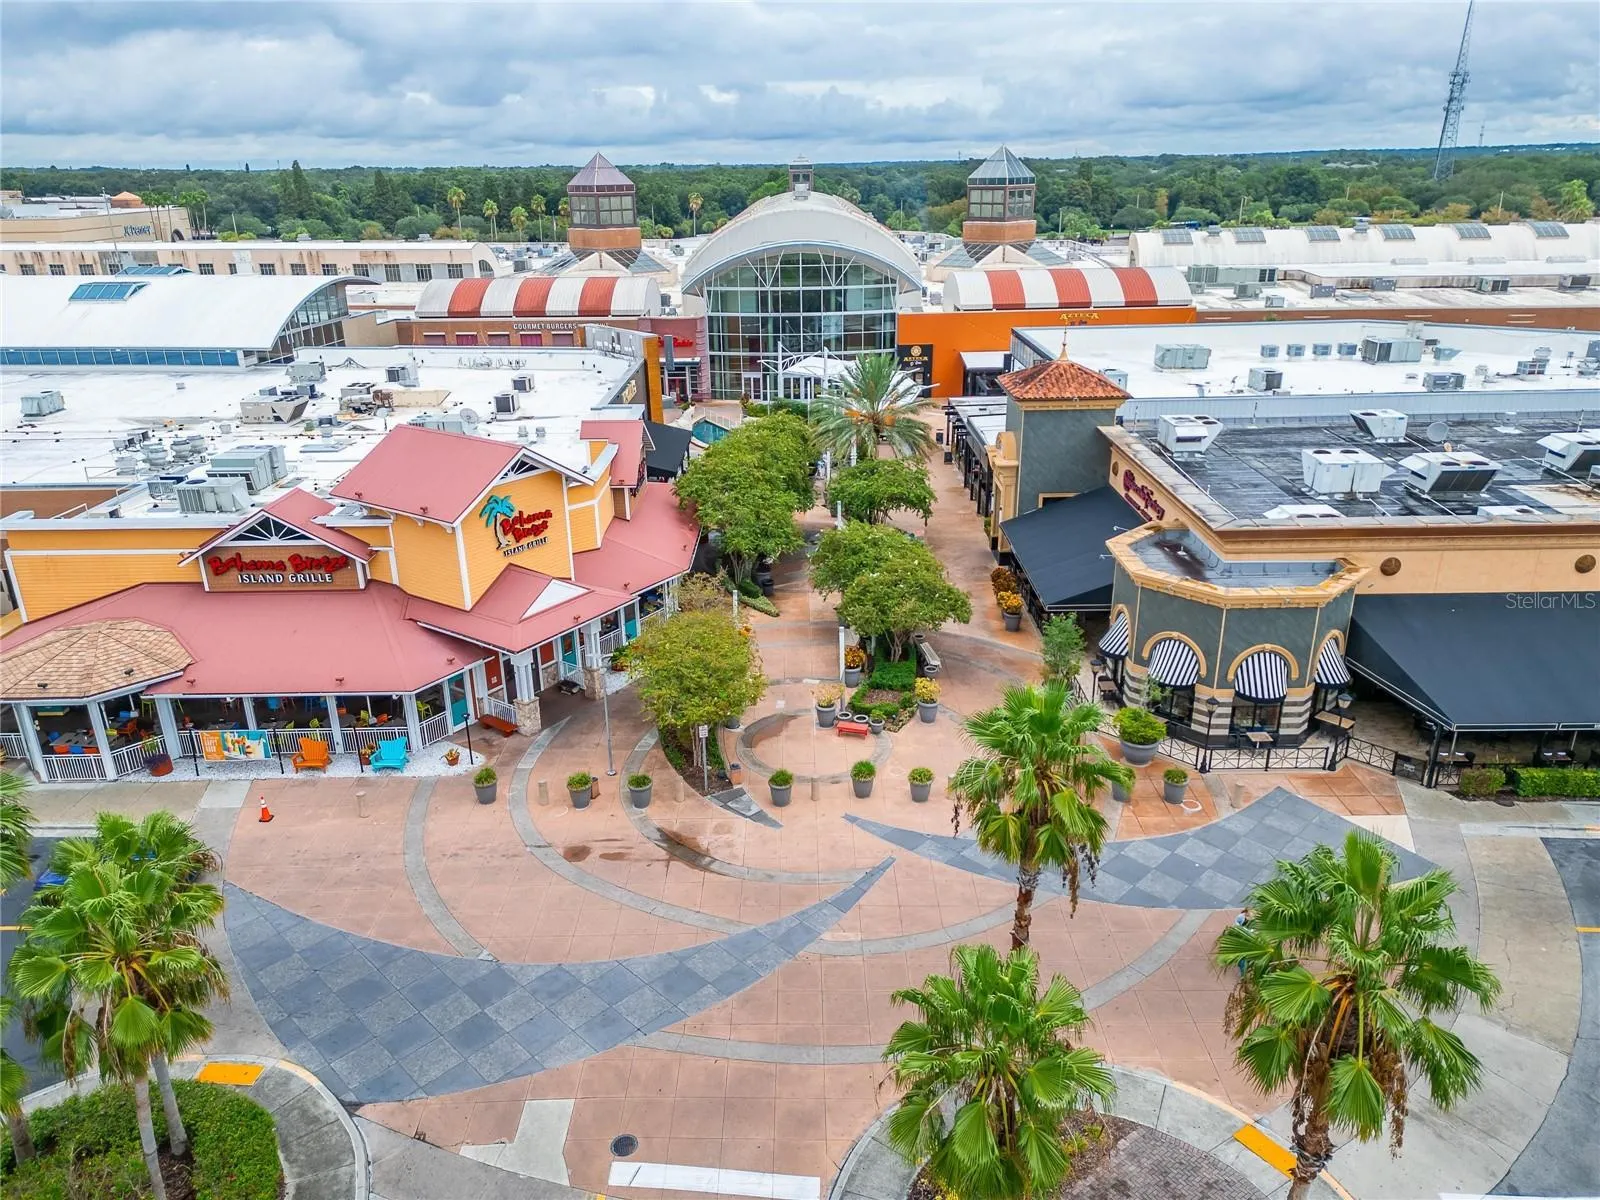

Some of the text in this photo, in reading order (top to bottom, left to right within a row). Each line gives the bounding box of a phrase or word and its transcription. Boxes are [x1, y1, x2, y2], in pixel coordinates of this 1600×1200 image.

[500, 510, 553, 536] Bahama
[512, 520, 549, 543] Breeze
[207, 552, 348, 577] Bahama Breeze
[237, 573, 333, 584] ISLAND GRILLE
